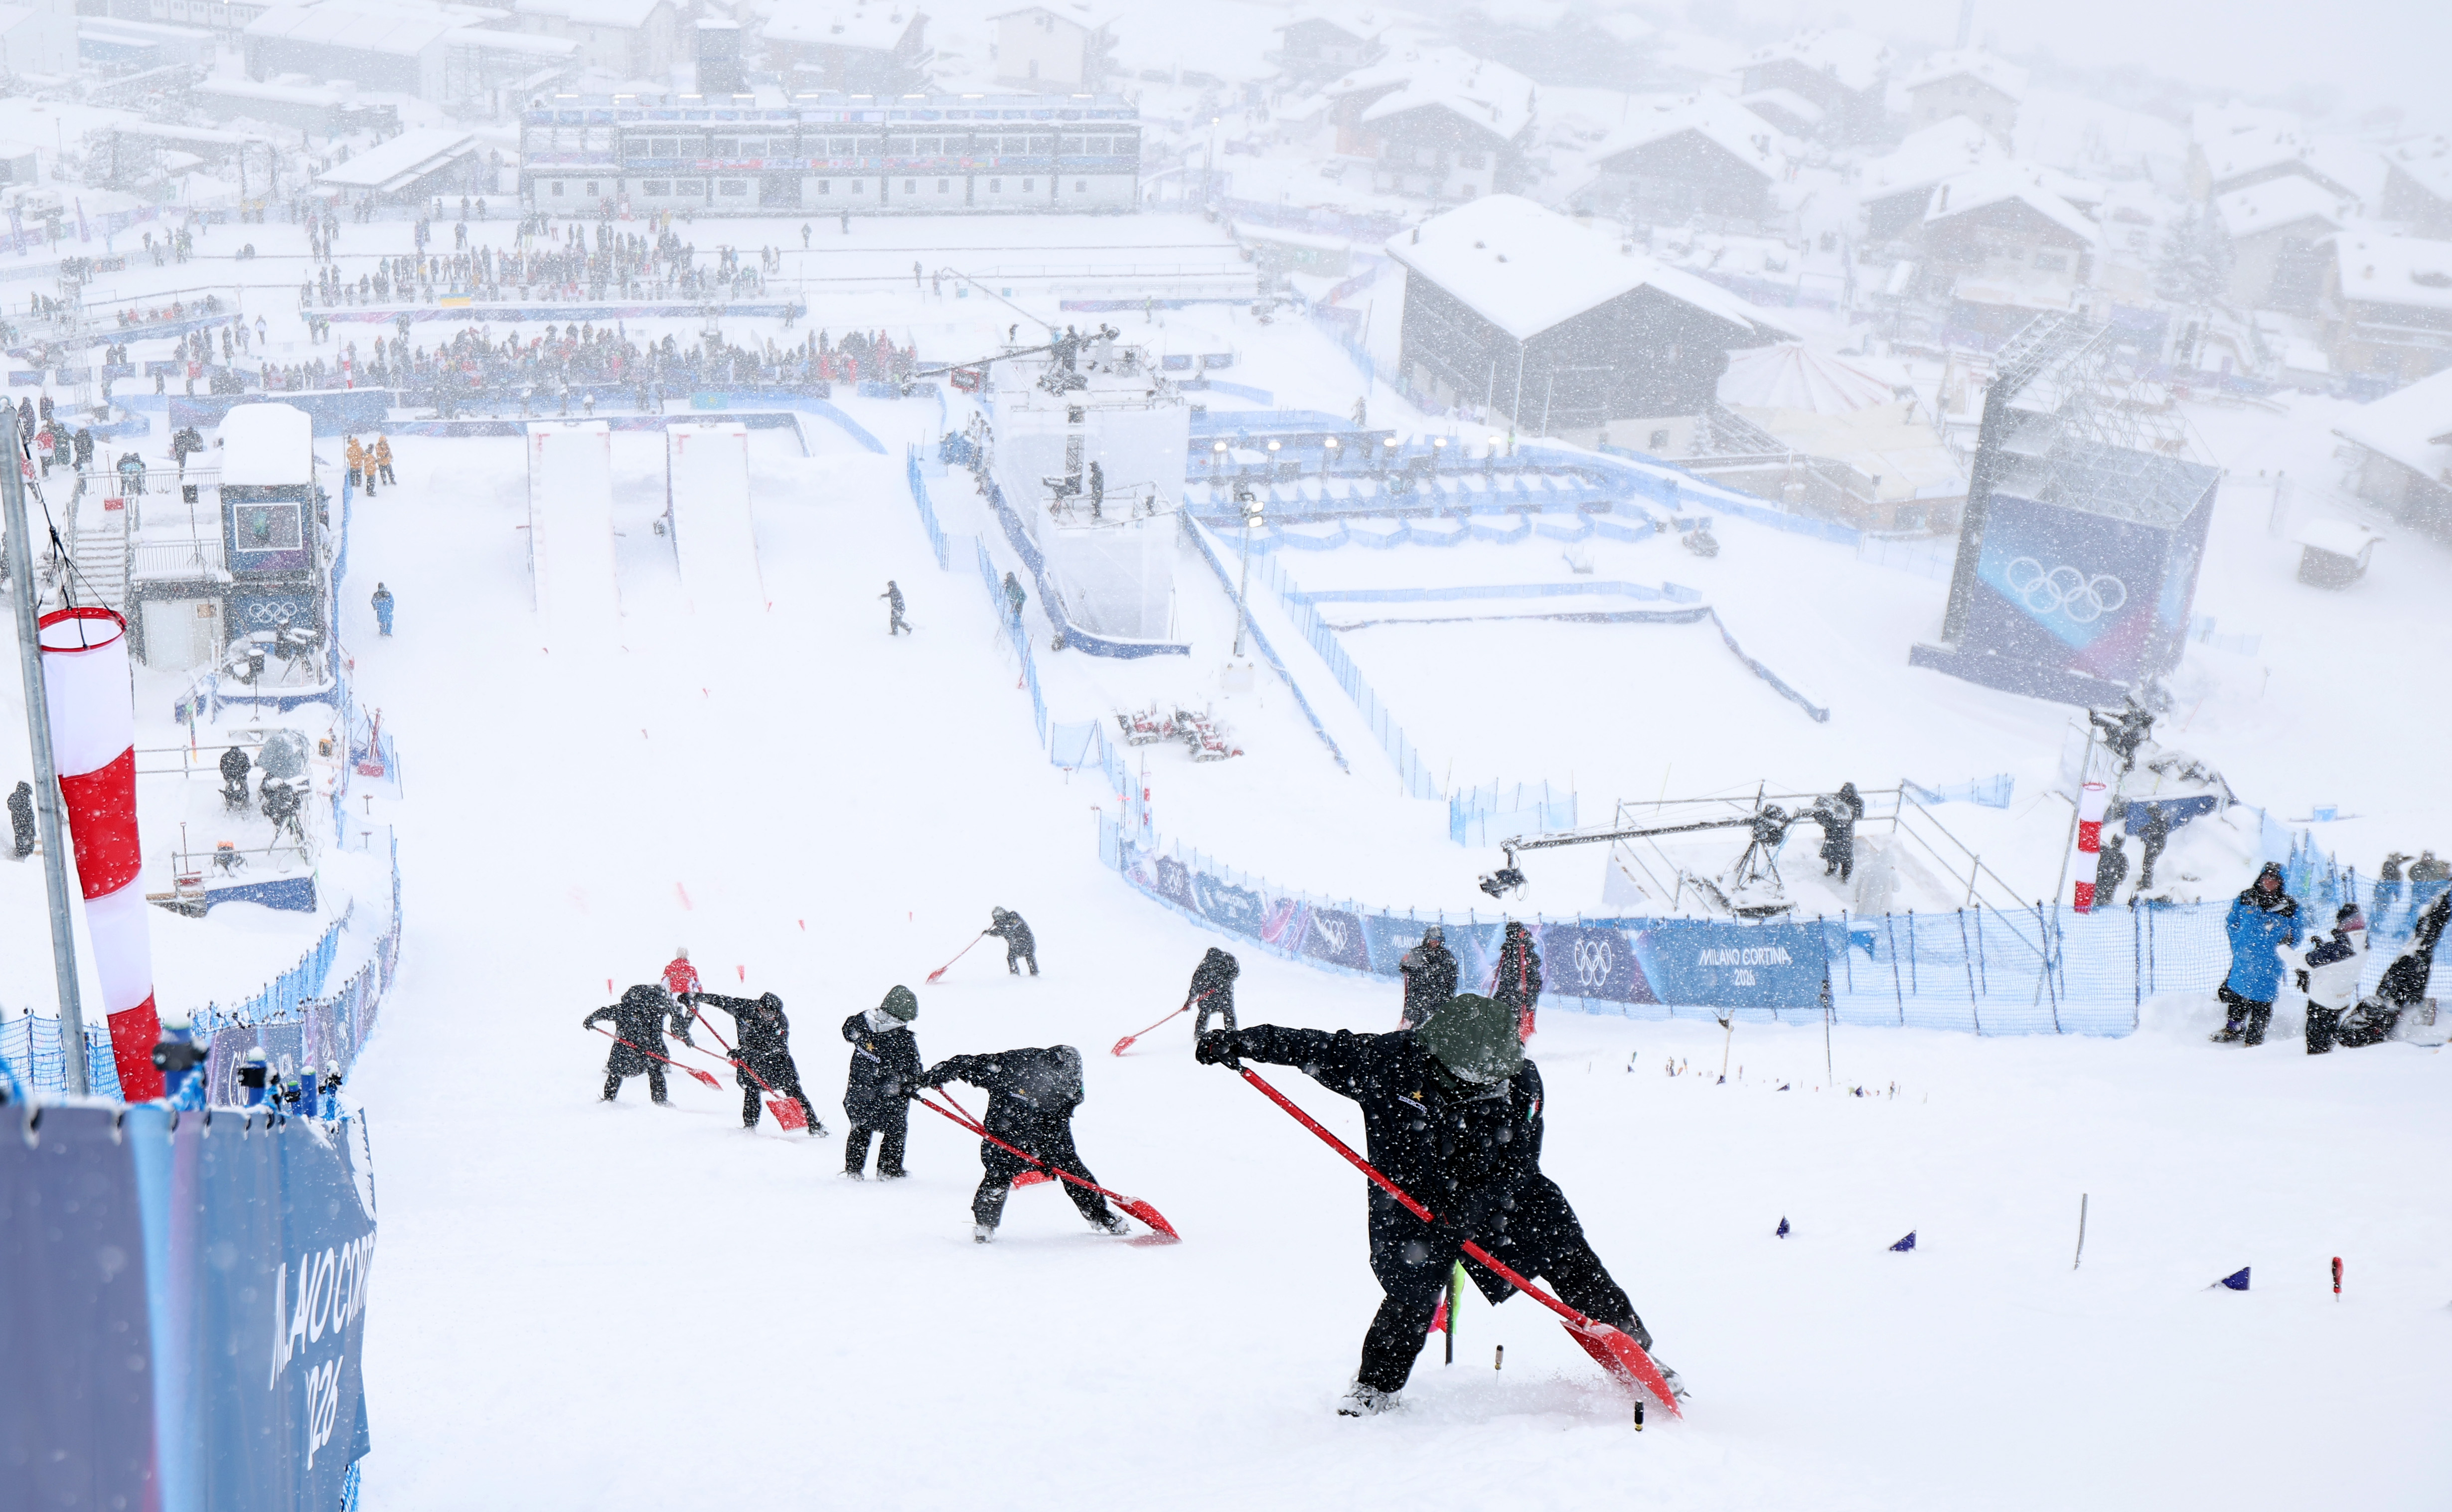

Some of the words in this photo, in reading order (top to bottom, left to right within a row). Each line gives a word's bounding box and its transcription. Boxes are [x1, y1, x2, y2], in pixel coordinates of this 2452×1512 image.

[1699, 949, 1740, 965] MILANO
[1742, 947, 1793, 965] CORTINA
[1734, 968, 1756, 986] 2026
[1398, 1095, 1427, 1113] ESERCITO
